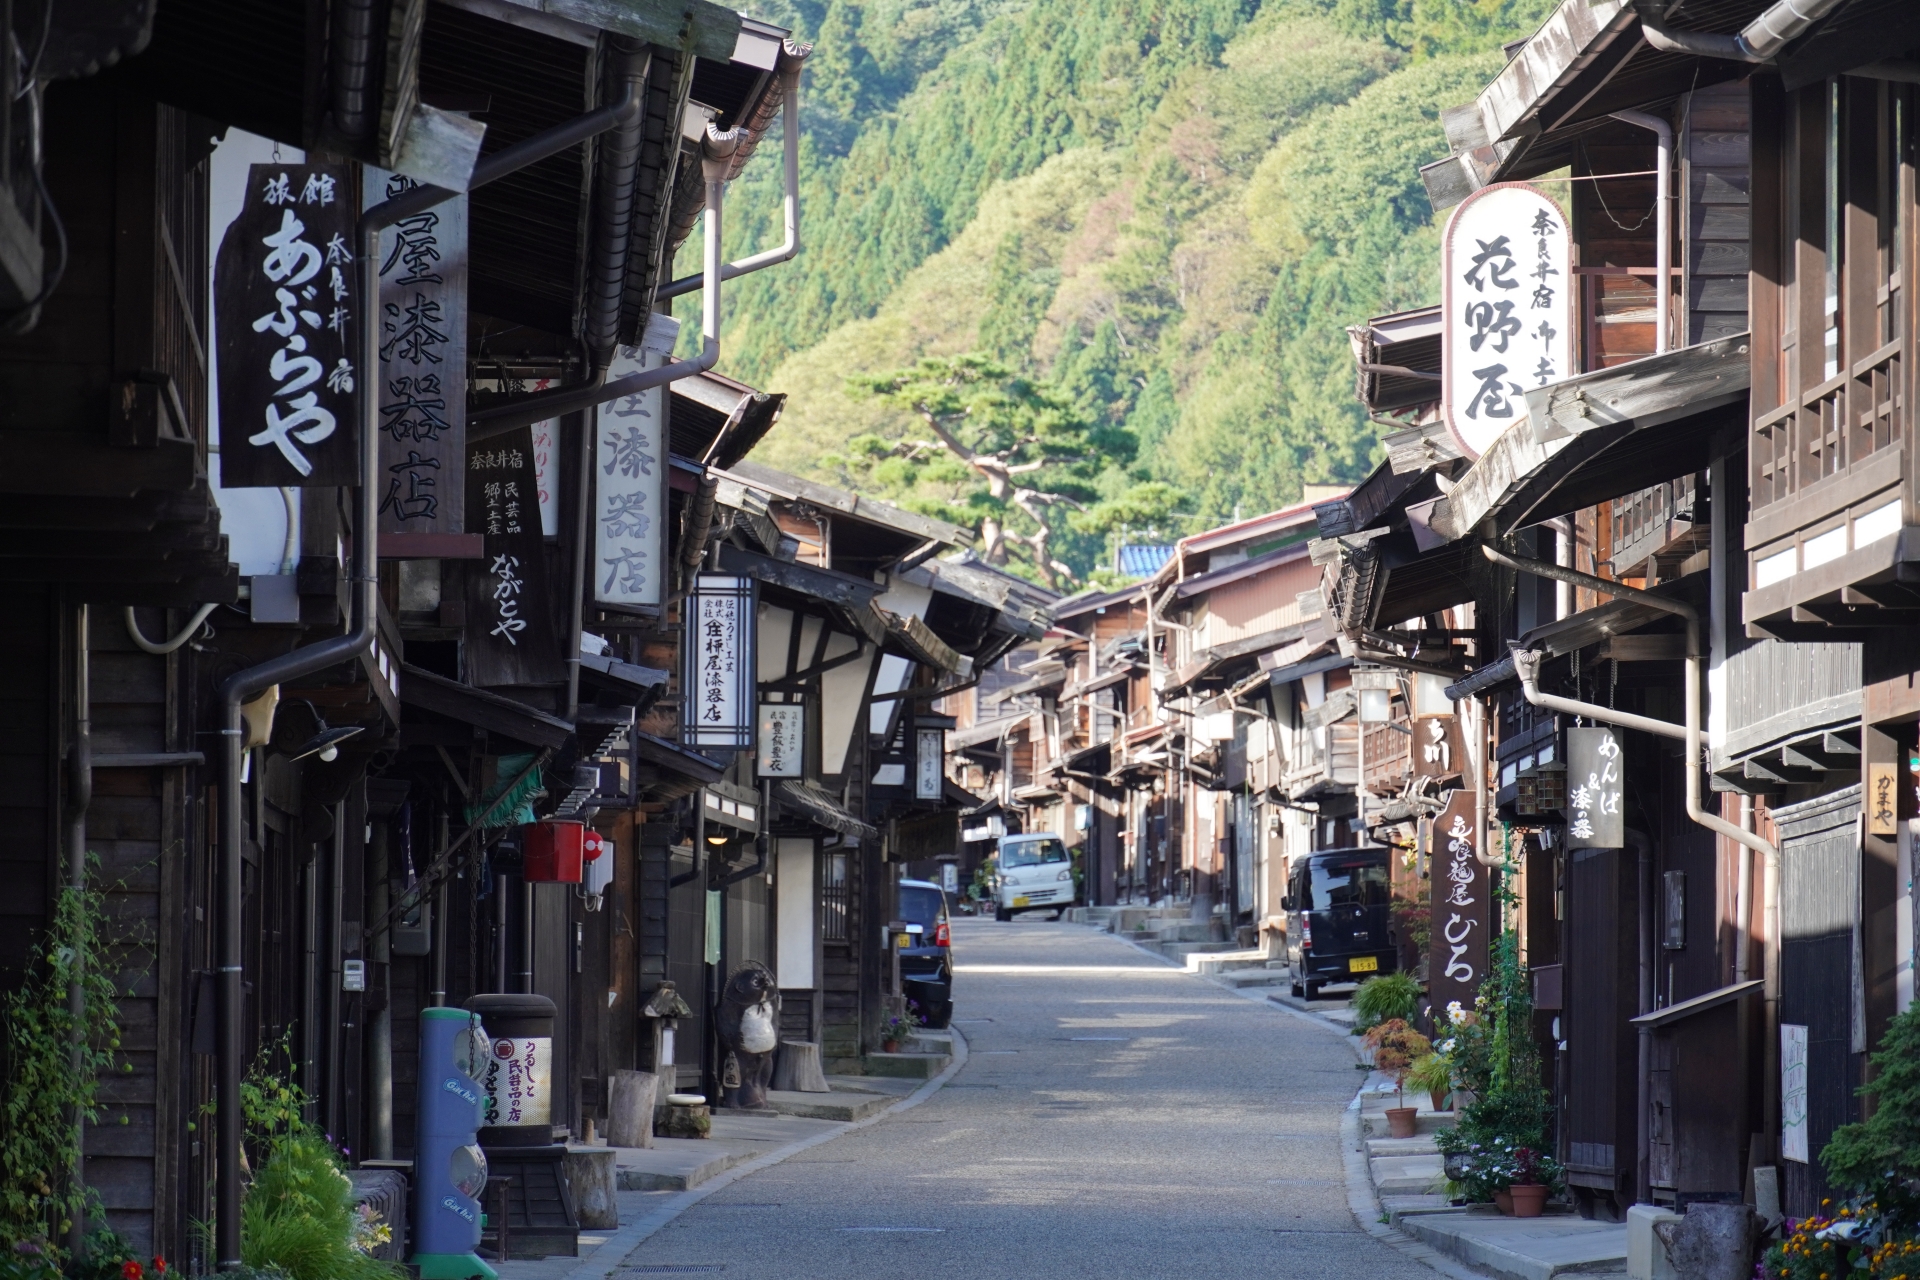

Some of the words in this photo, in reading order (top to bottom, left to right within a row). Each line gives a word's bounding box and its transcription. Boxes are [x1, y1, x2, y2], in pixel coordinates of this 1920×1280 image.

[262, 173, 336, 206] 旅館
[1530, 208, 1559, 309] 奈良井宿
[325, 232, 355, 395] 奈良井宿
[1463, 235, 1524, 420] 花野屋
[248, 208, 336, 478] あぶらや
[471, 449, 523, 469] 奈良井宿
[484, 482, 502, 535] 郷土土産
[504, 482, 522, 534] 民芸品
[490, 553, 527, 646] ながとや
[1588, 772, 1601, 790] &
[1874, 774, 1895, 827] かまや
[1570, 784, 1595, 839] 漆の器
[1444, 912, 1478, 982] ひろ
[507, 1059, 523, 1122] 民芸品の店
[524, 1041, 536, 1098] うるしと
